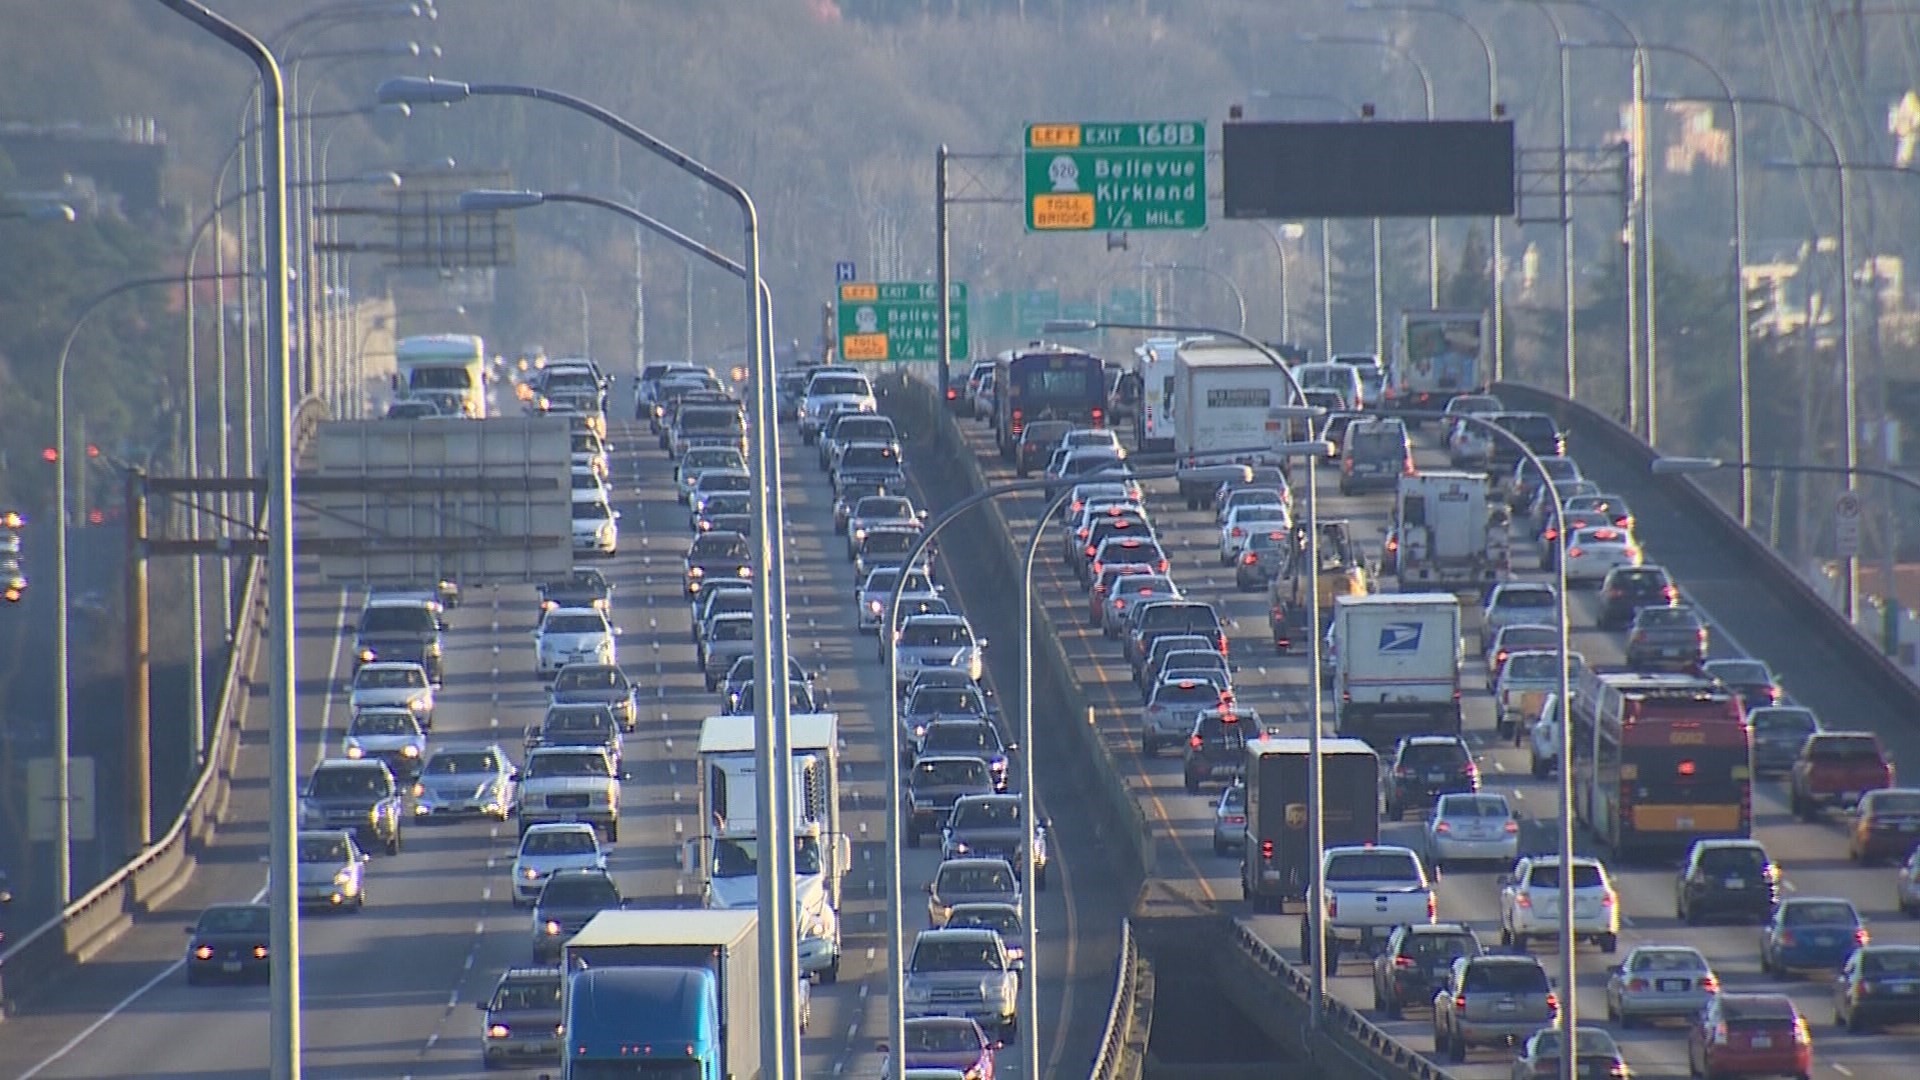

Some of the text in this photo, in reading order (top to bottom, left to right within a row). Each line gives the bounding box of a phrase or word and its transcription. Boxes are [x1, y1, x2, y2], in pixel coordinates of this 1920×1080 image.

[1035, 125, 1195, 145] LEFT EXIT 168B
[1095, 159, 1195, 178] Bellevue
[1097, 183, 1195, 201] Kirkland
[1145, 209, 1184, 225] MILE
